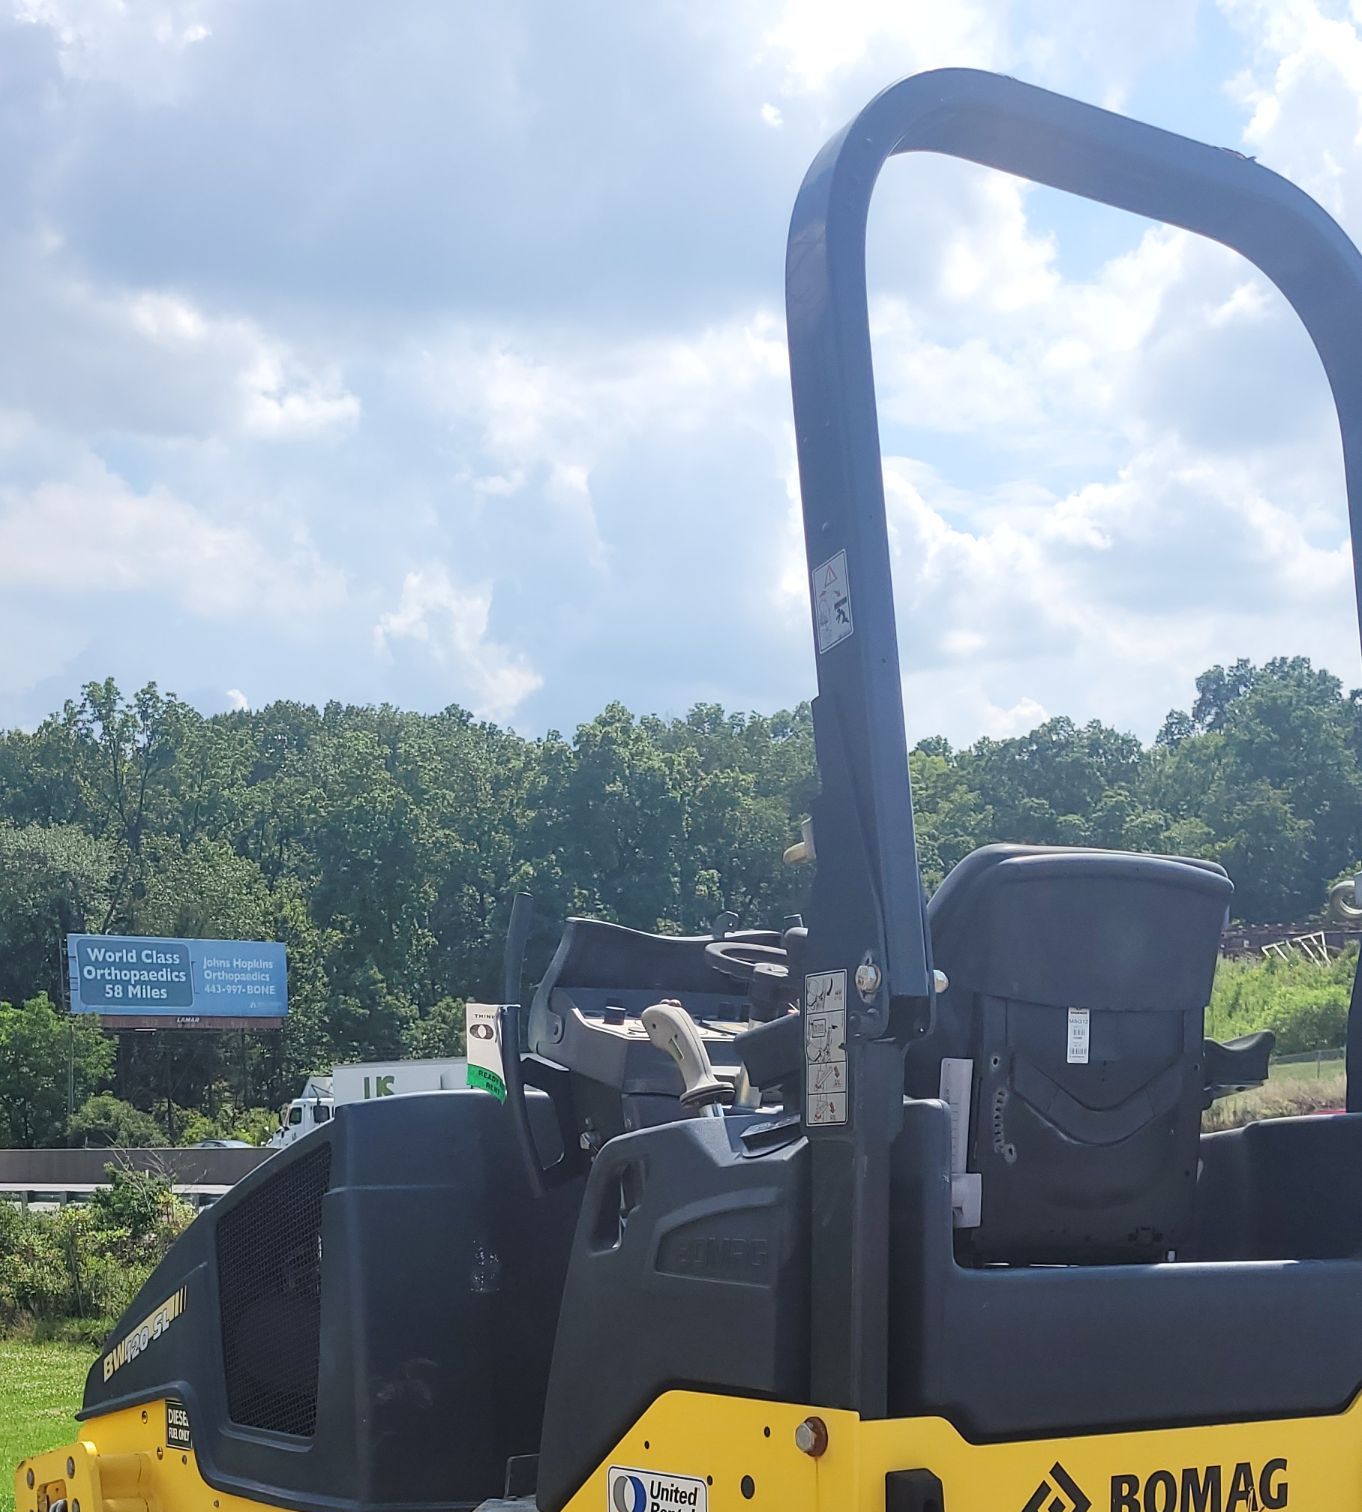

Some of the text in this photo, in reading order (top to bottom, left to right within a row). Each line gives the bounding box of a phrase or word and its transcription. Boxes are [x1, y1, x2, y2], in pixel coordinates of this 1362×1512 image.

[87, 948, 180, 964] World Class
[203, 957, 273, 971] Johns Hopkins
[83, 965, 186, 983] Orthopaedics
[204, 970, 270, 983] Orthopaedics
[105, 985, 167, 999] 58 Miles
[204, 984, 276, 995] 443-997-BONE
[169, 1427, 178, 1439] FUEL
[650, 1480, 698, 1506] United
